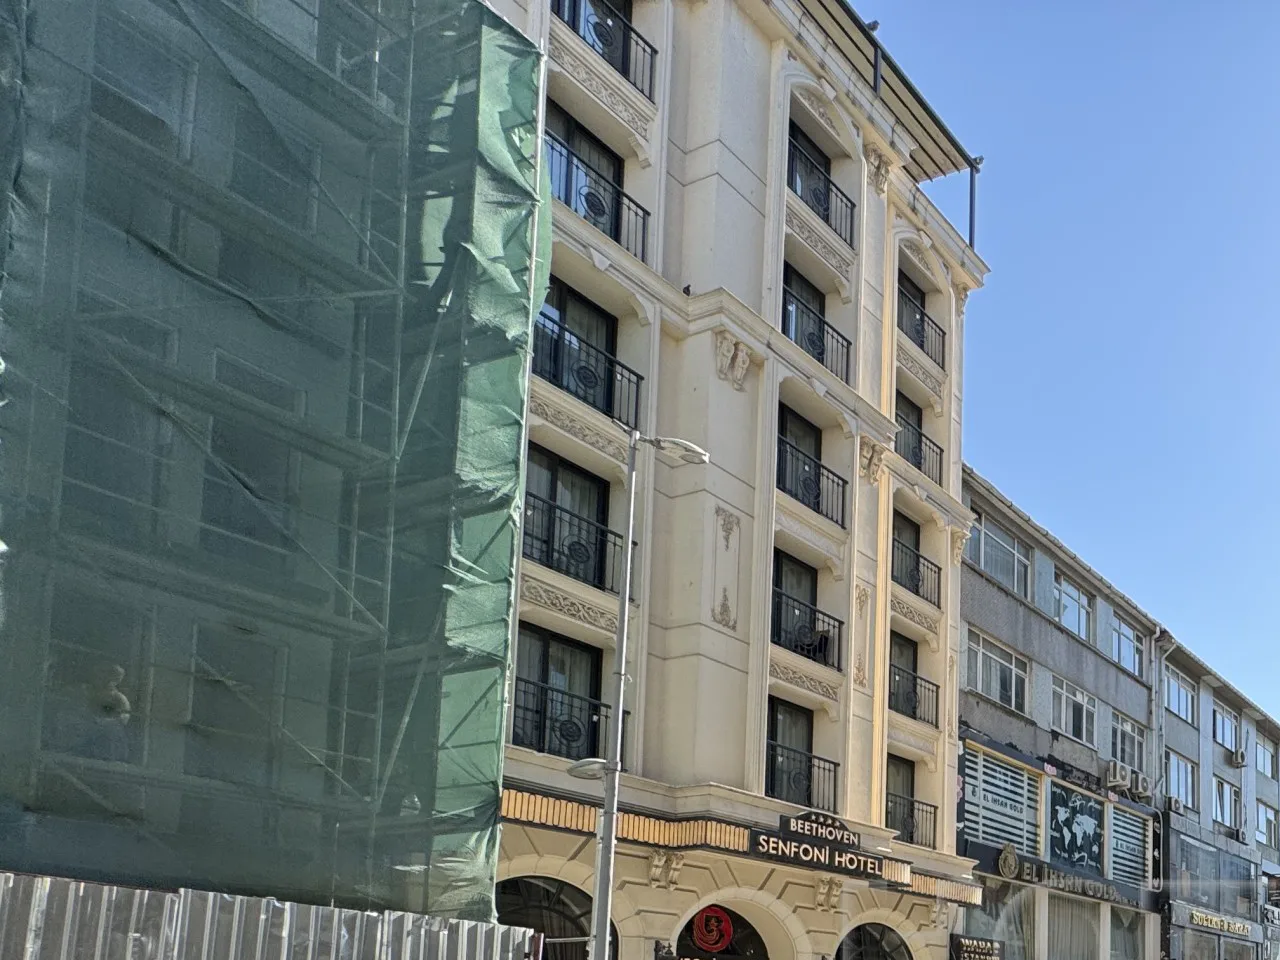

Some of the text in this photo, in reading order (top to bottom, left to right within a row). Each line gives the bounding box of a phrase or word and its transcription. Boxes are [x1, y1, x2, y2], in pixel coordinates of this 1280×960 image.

[790, 818, 859, 846] BEETHOVEN
[758, 835, 882, 875] SENFONİ HOTEL
[1021, 862, 1039, 882] EL
